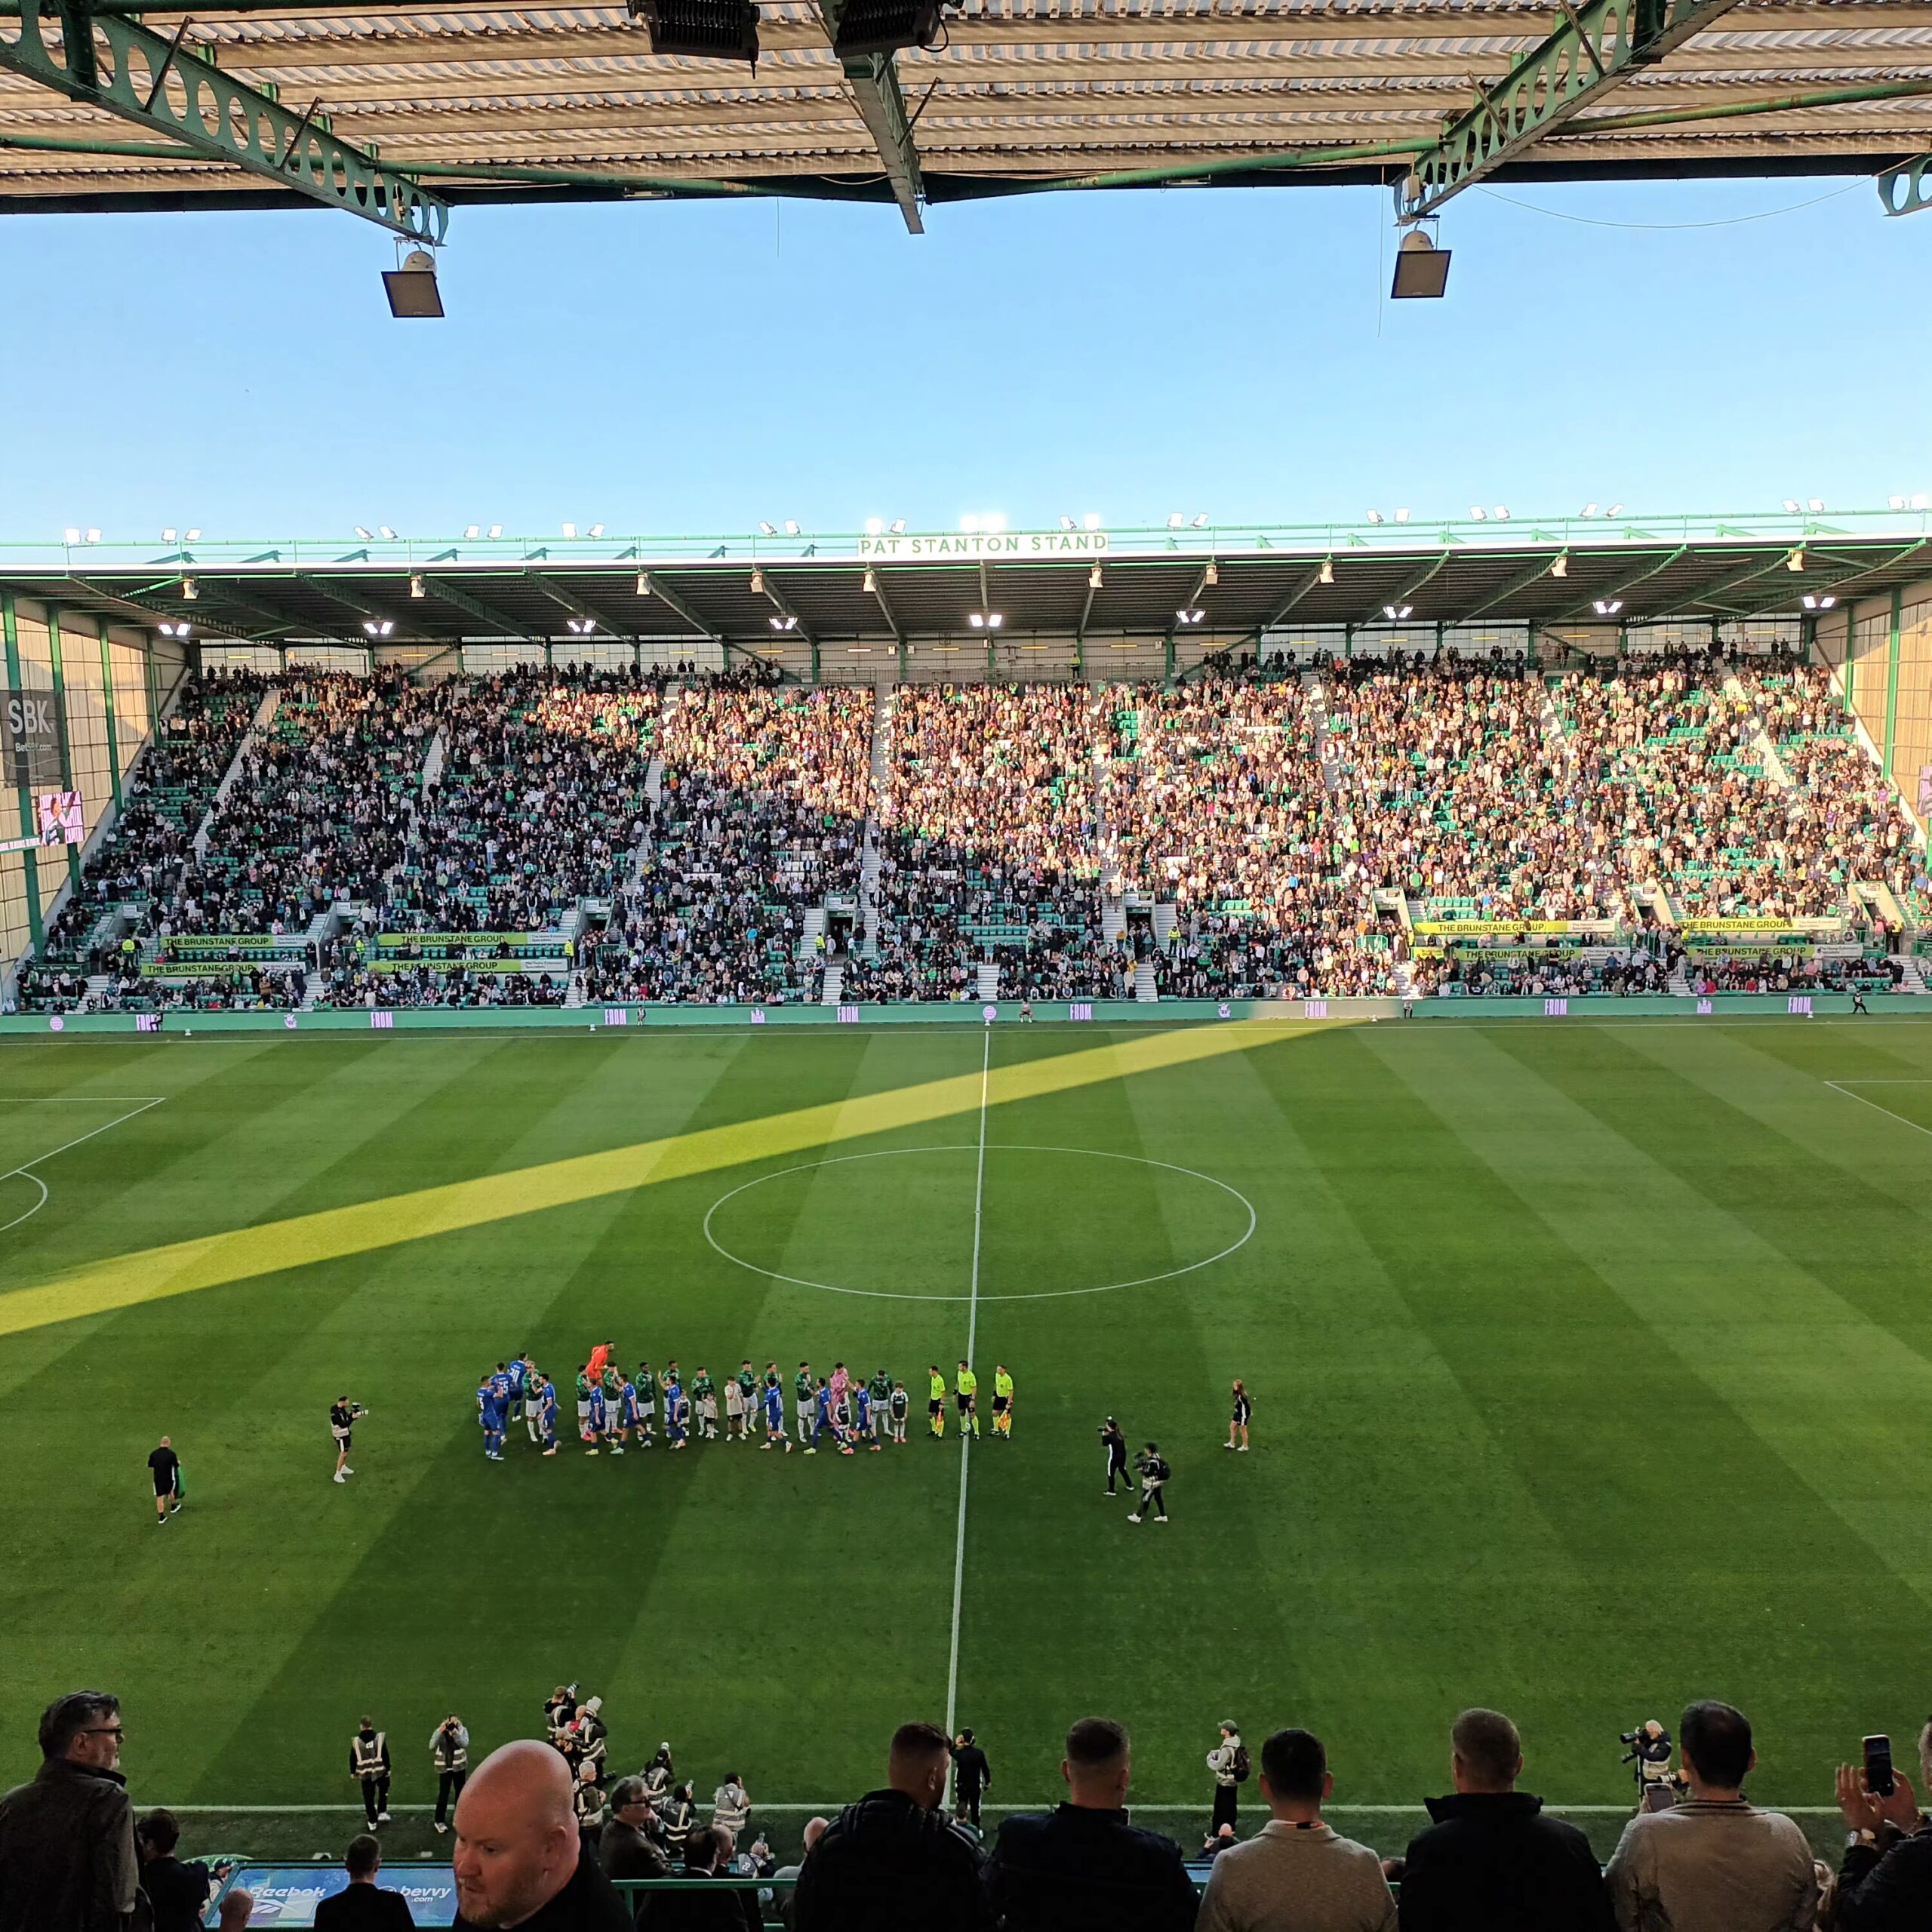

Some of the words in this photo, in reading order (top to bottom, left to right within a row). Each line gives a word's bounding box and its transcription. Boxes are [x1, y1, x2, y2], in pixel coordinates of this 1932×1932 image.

[860, 540, 900, 554] PAT
[912, 537, 1019, 553] STANTON
[1032, 535, 1106, 550] STAND
[8, 699, 51, 734] SBK
[1070, 1004, 1091, 1020] FROM
[1305, 1001, 1327, 1017] FROM
[1545, 999, 1567, 1015] FROM
[1788, 997, 1810, 1013] FROM
[371, 1011, 392, 1028] FROM
[605, 1008, 626, 1025] FROM
[837, 1006, 859, 1022] FROM
[742, 1862, 751, 1872] 22
[250, 1886, 327, 1898] Reebok
[399, 1885, 451, 1899] bevvy
